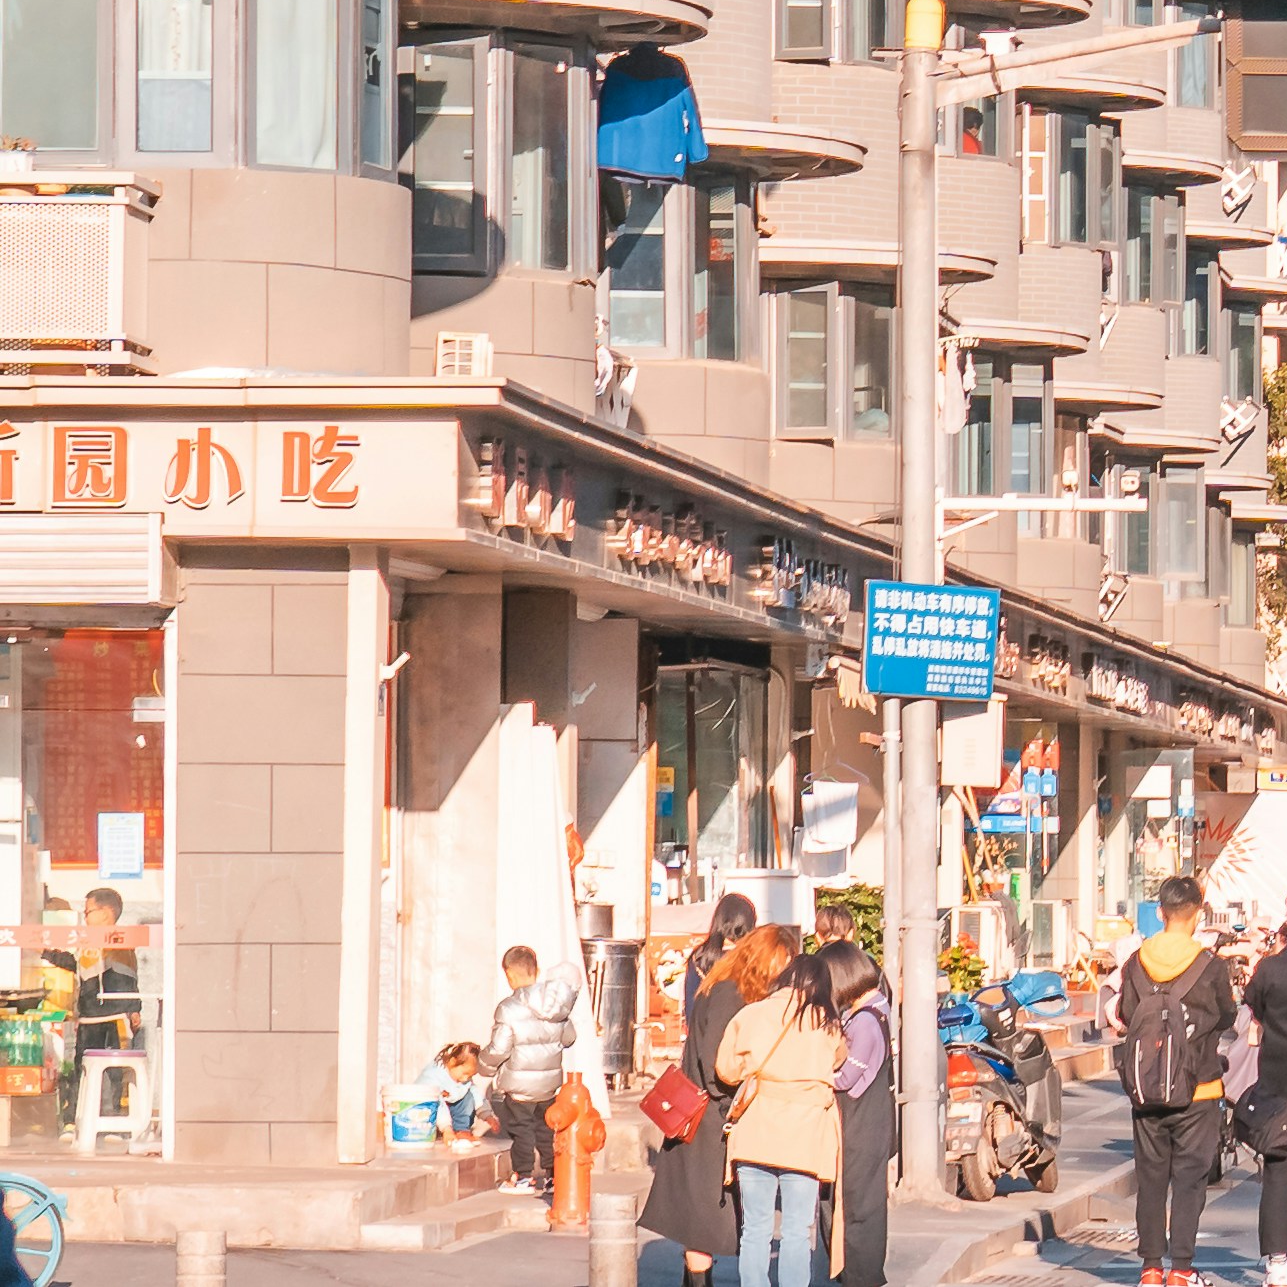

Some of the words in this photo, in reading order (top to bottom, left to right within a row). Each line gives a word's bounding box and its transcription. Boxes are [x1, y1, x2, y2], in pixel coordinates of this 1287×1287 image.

[873, 612, 992, 640] 不得占用快车道，
